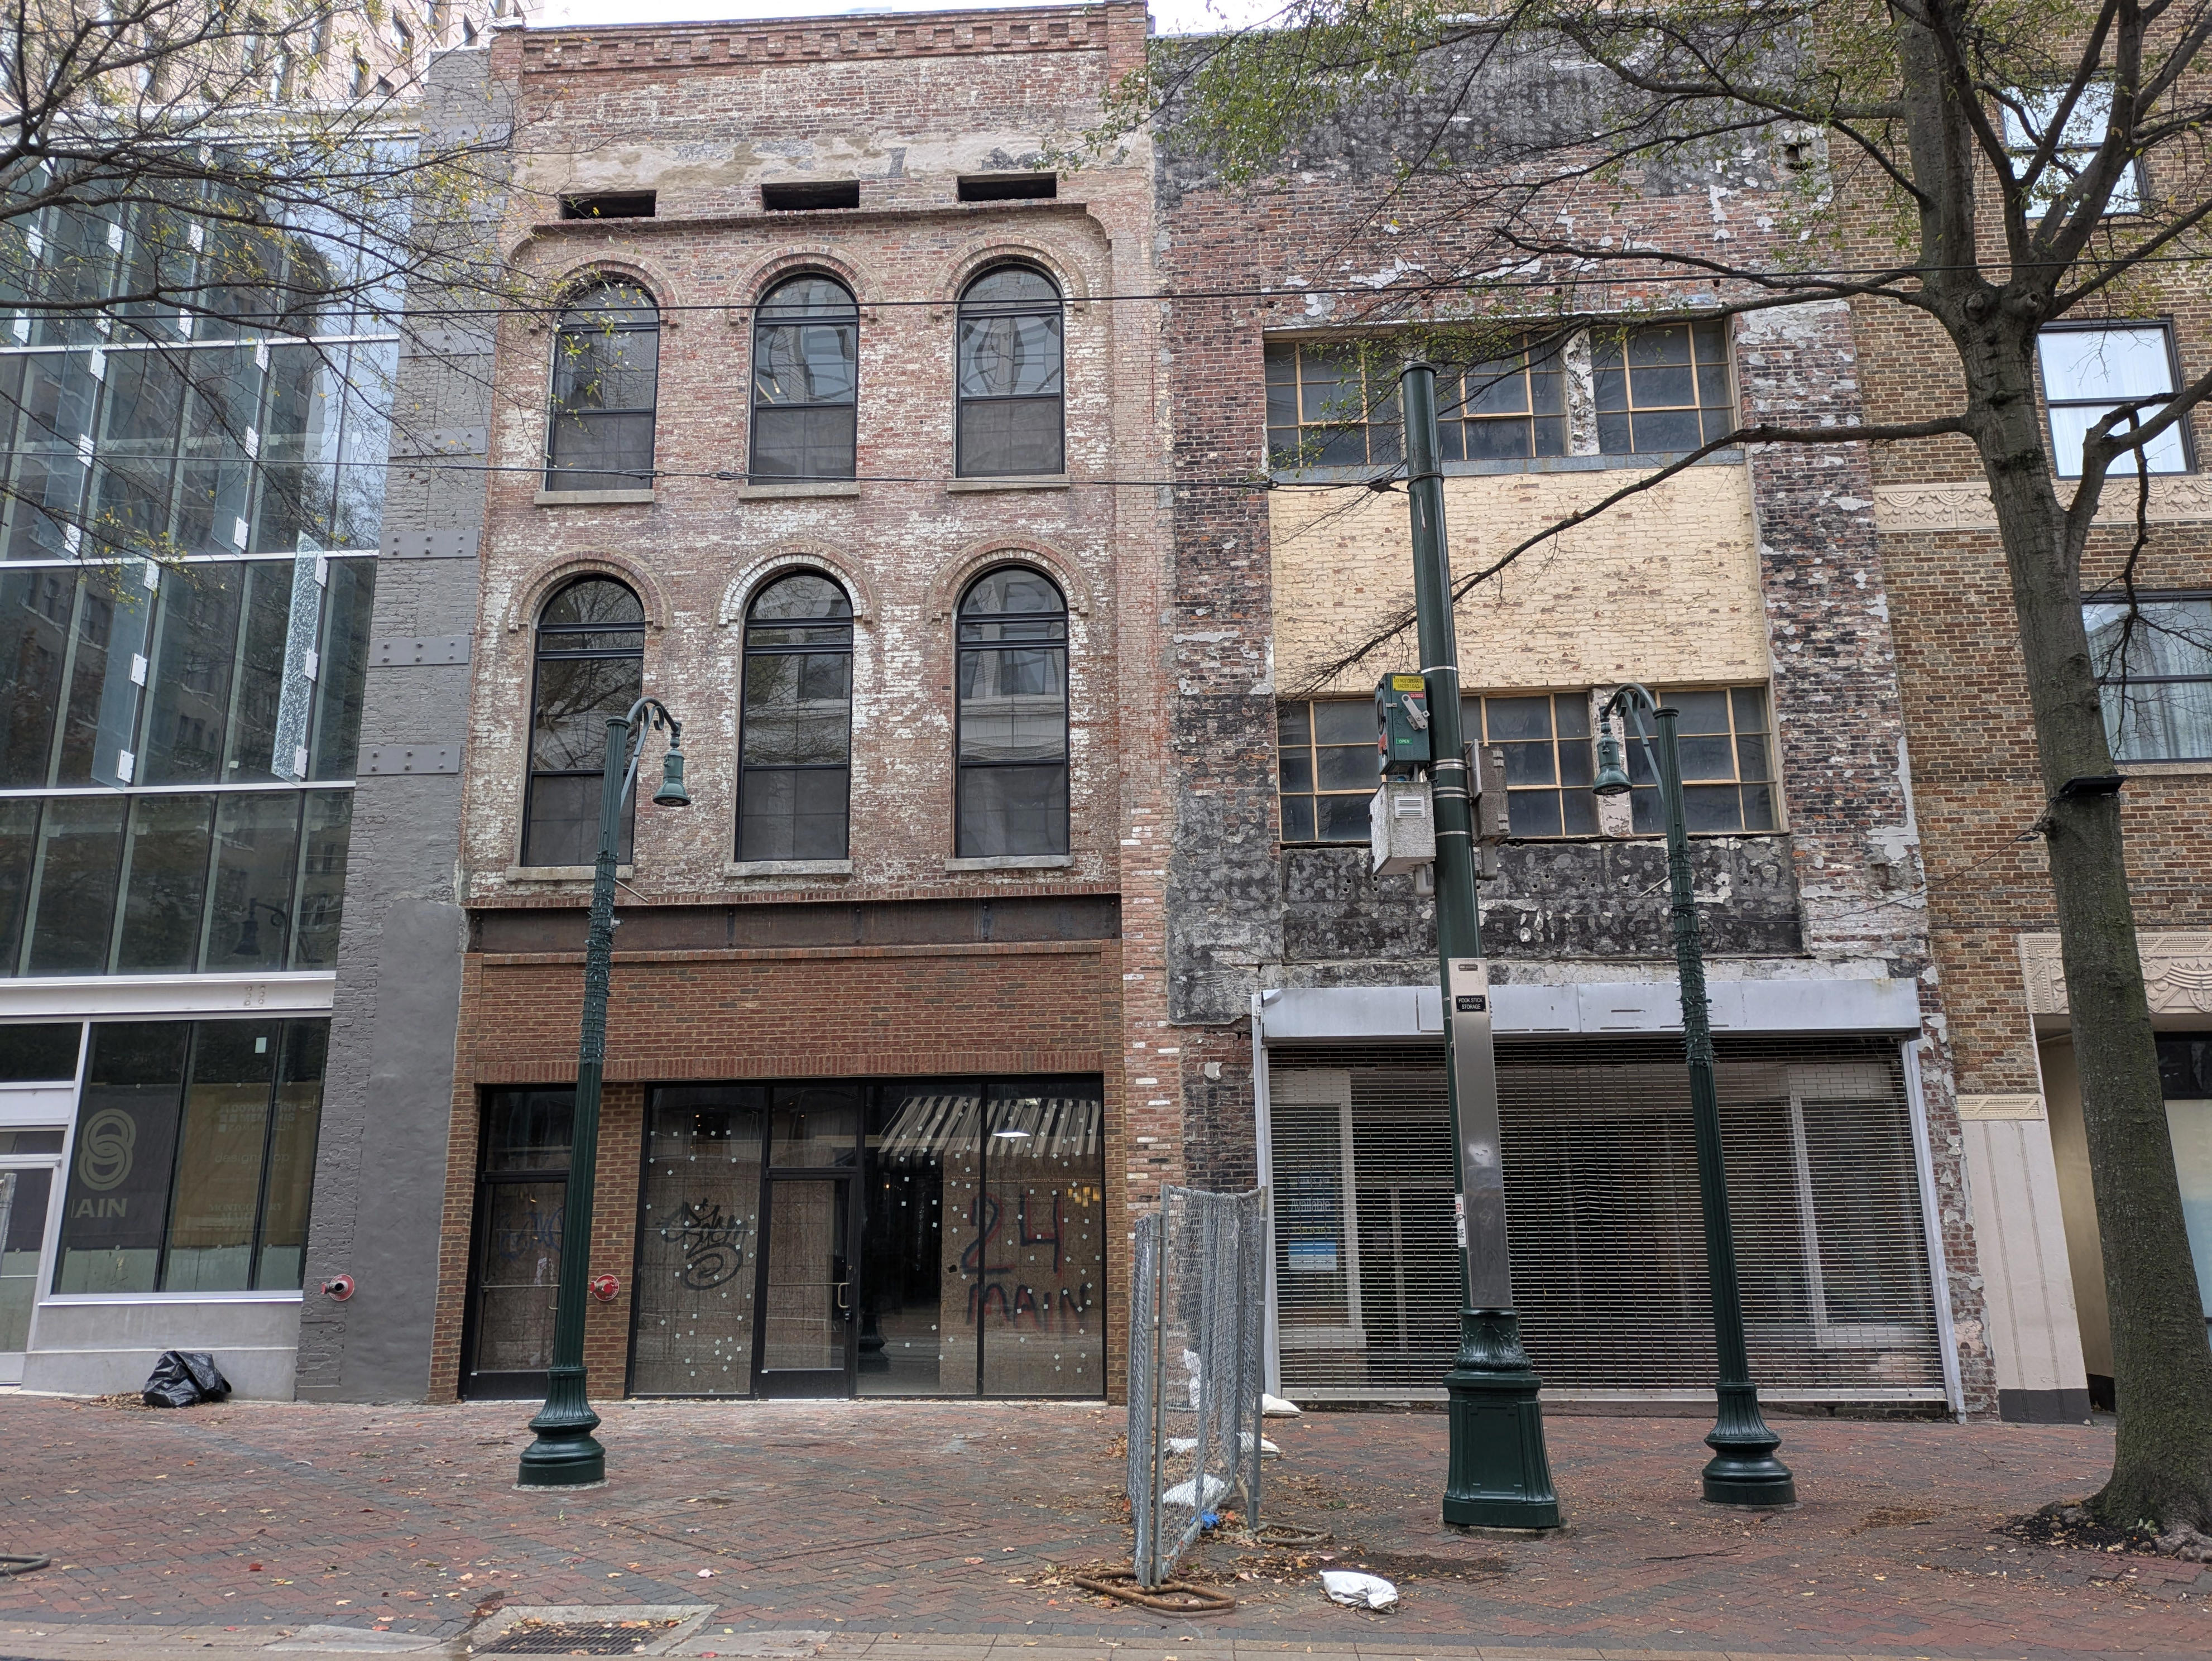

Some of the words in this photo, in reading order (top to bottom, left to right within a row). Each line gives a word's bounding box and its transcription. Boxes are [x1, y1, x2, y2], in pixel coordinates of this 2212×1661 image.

[70, 1198, 128, 1218] AIN
[1290, 1197, 1331, 1211] Available
[962, 1192, 1064, 1277] 24
